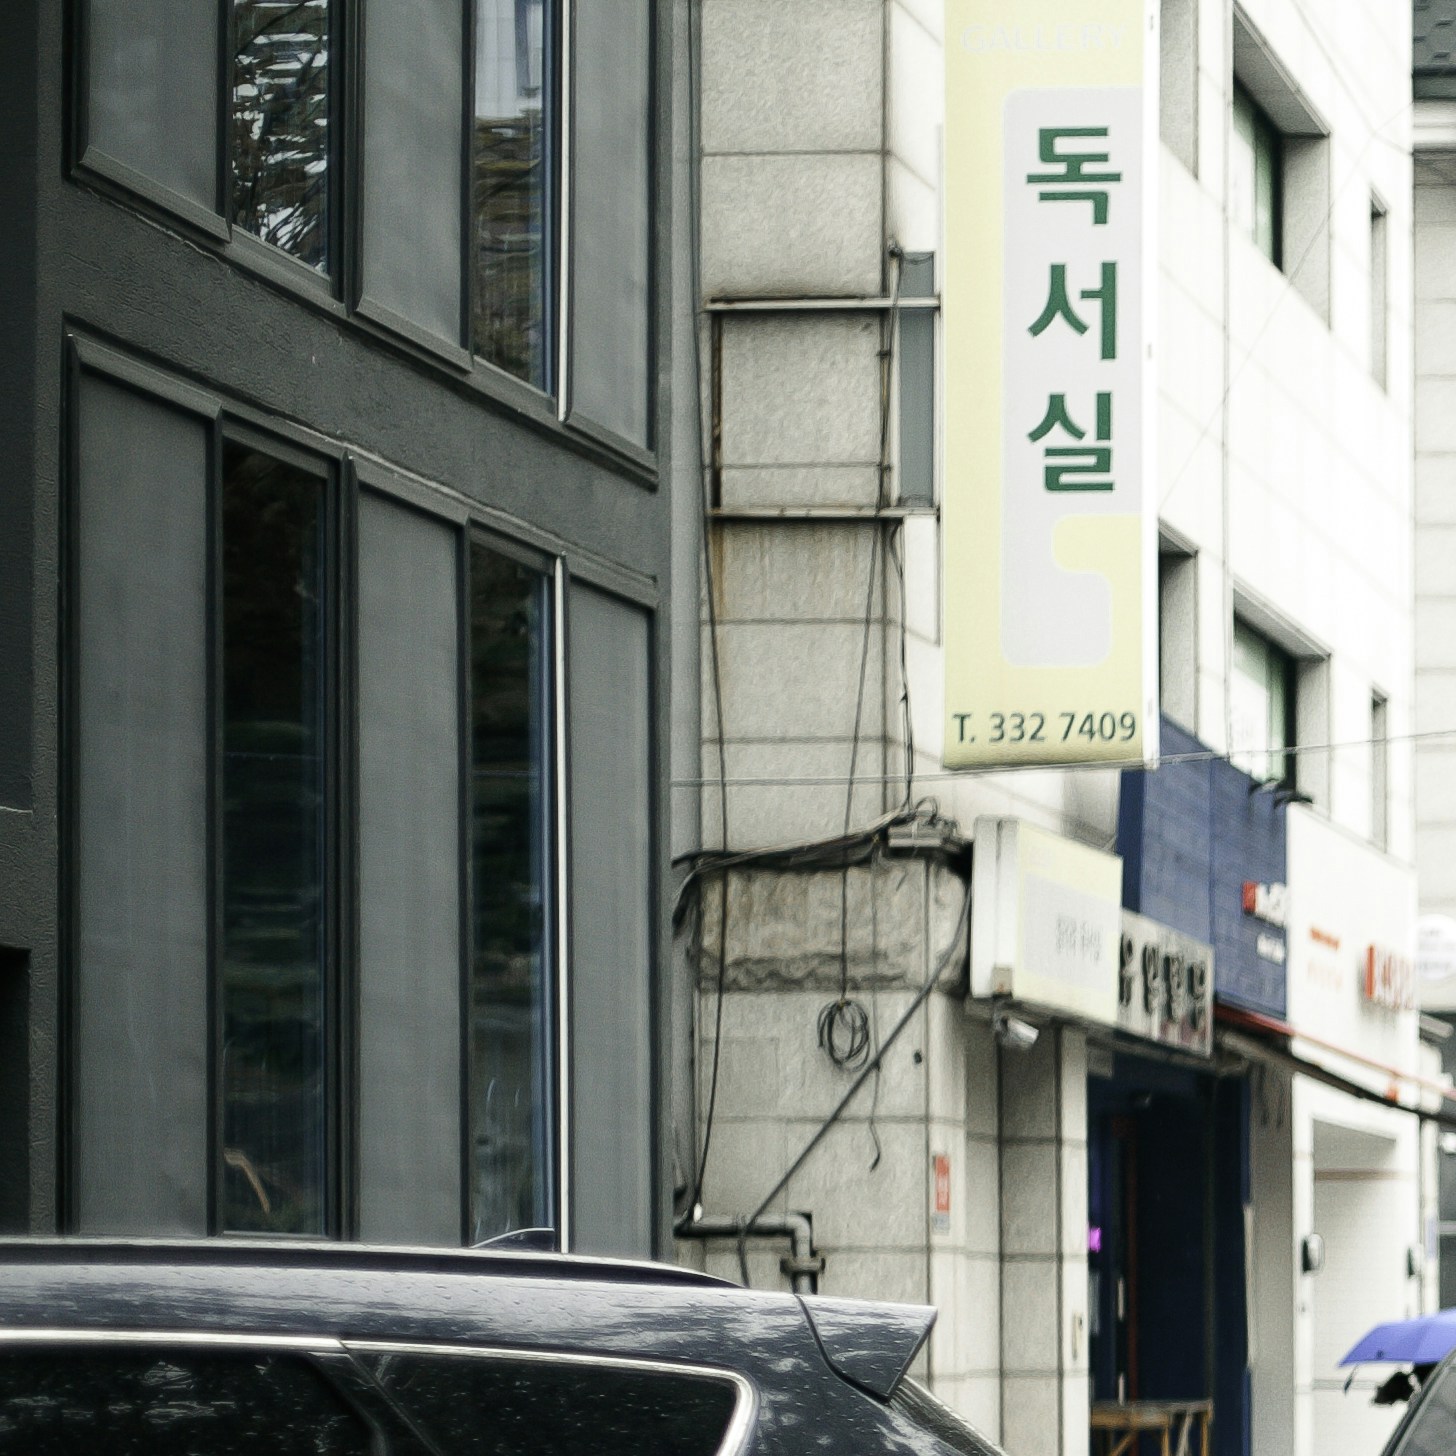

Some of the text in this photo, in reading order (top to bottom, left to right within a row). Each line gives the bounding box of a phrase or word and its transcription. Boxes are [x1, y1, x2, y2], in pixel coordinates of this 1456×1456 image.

[961, 23, 1126, 53] GALLERY
[1026, 127, 1122, 492] 독서실
[953, 711, 1137, 743] T. 332 7409
